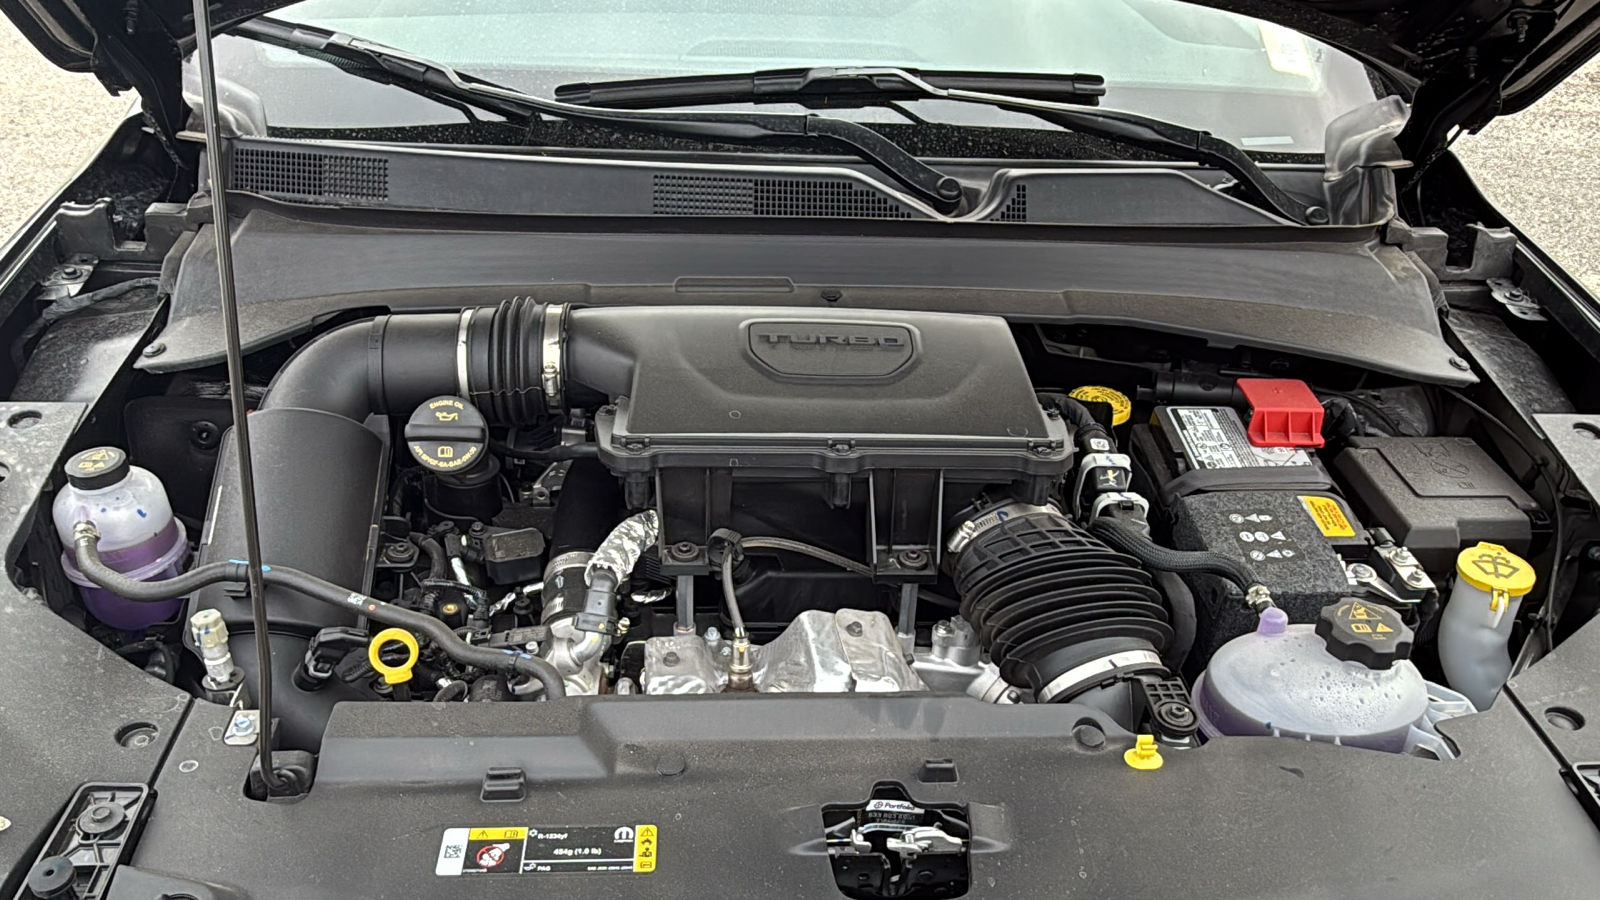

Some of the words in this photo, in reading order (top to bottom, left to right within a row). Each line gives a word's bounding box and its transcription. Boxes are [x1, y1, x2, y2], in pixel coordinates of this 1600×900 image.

[758, 334, 904, 348] TURBO
[429, 400, 454, 410] ENGINE
[454, 401, 464, 410] OIL
[414, 446, 423, 456] API
[885, 802, 915, 811] Portfolio
[553, 848, 573, 856] 454g
[574, 848, 590, 856] (1.0
